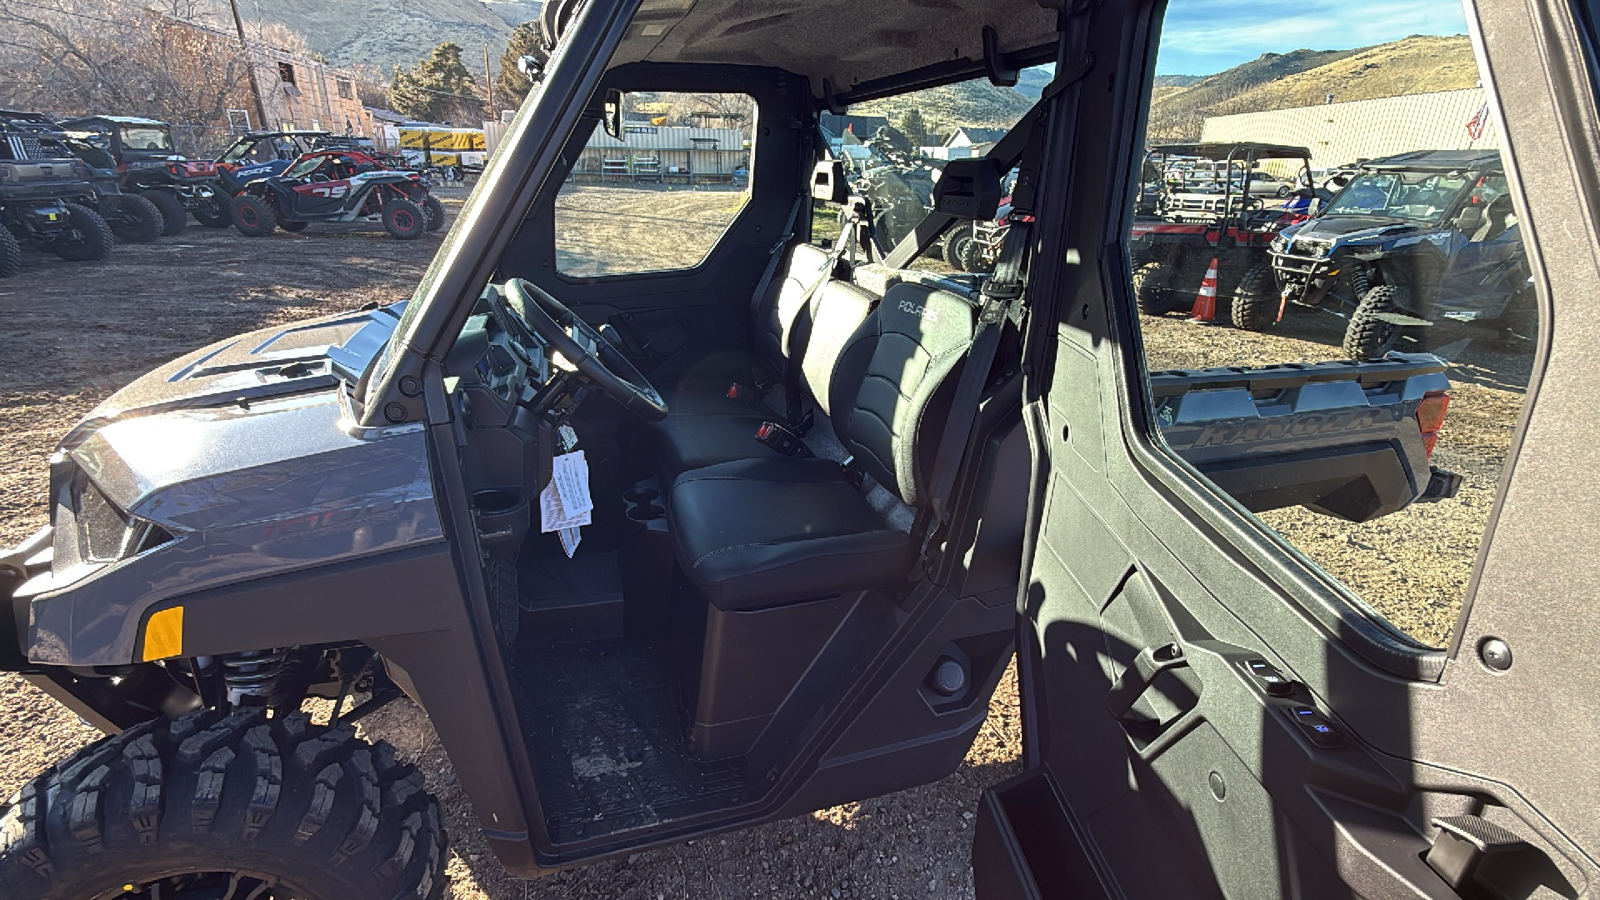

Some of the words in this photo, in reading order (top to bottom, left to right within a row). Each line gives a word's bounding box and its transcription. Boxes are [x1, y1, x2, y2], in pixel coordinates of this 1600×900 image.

[236, 166, 272, 179] RZR
[1427, 232, 1452, 240] XP
[897, 300, 939, 321] POLARIS
[1191, 409, 1380, 448] RANGER
